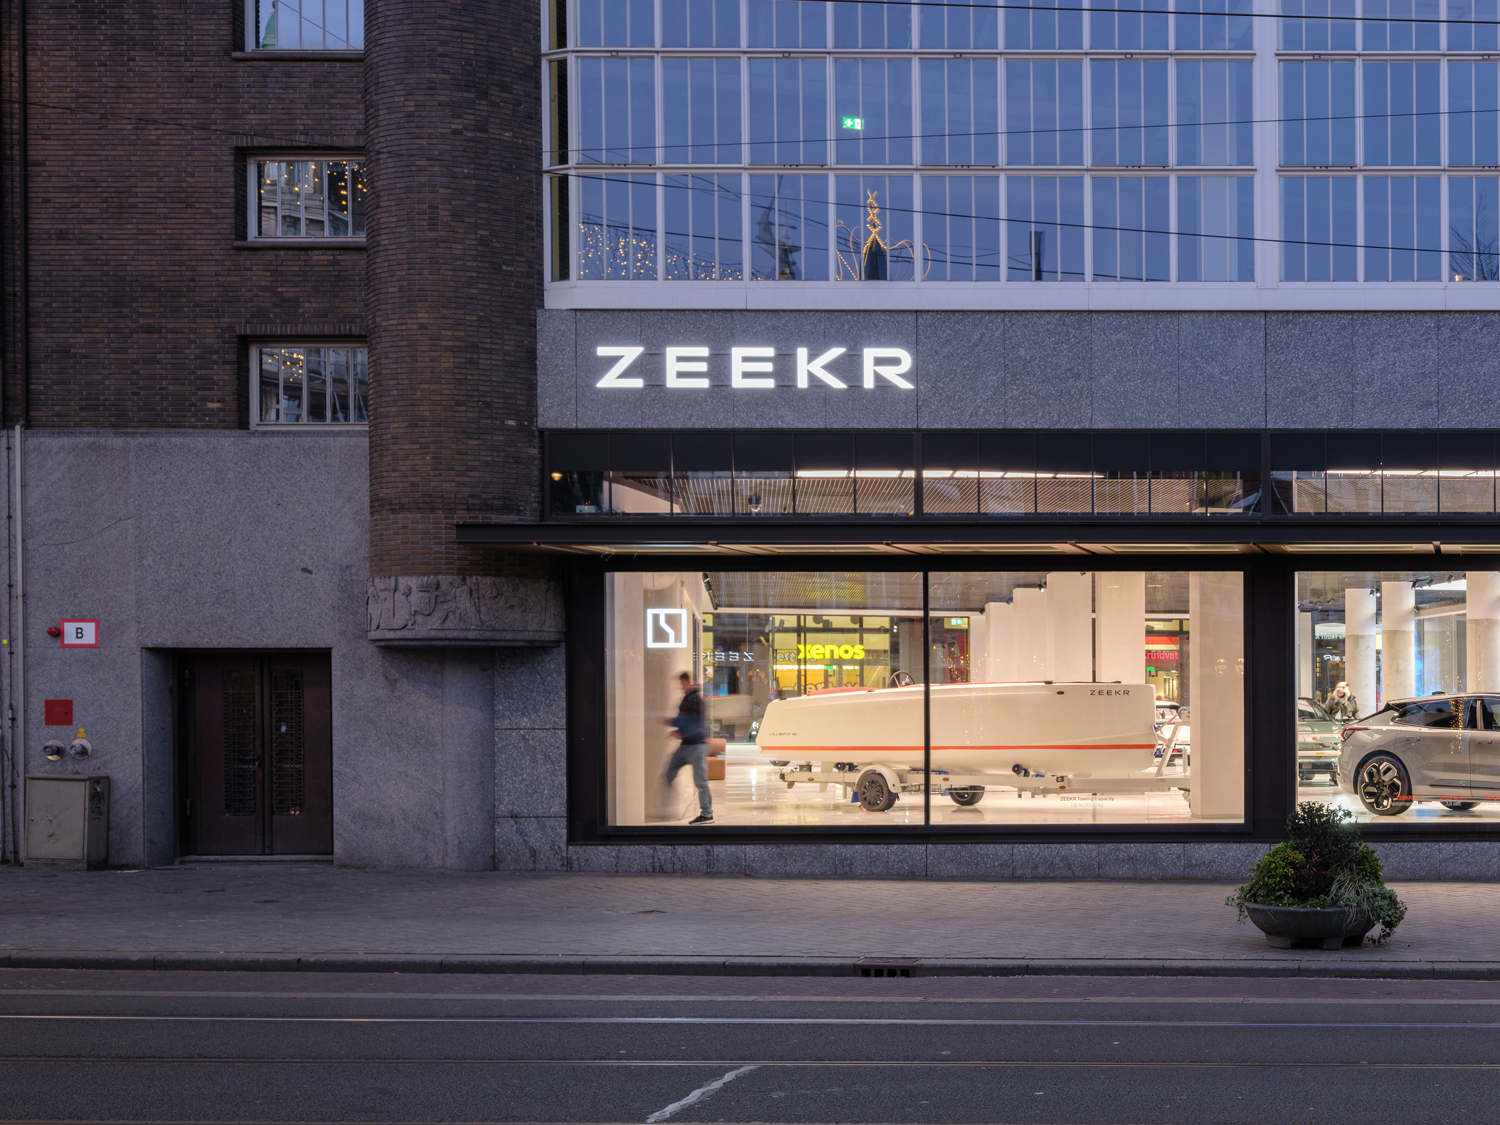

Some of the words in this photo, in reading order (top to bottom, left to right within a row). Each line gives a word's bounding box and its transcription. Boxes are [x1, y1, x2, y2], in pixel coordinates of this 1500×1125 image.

[595, 346, 915, 389] ZEEKR
[75, 627, 84, 639] B
[797, 644, 865, 660] xenos
